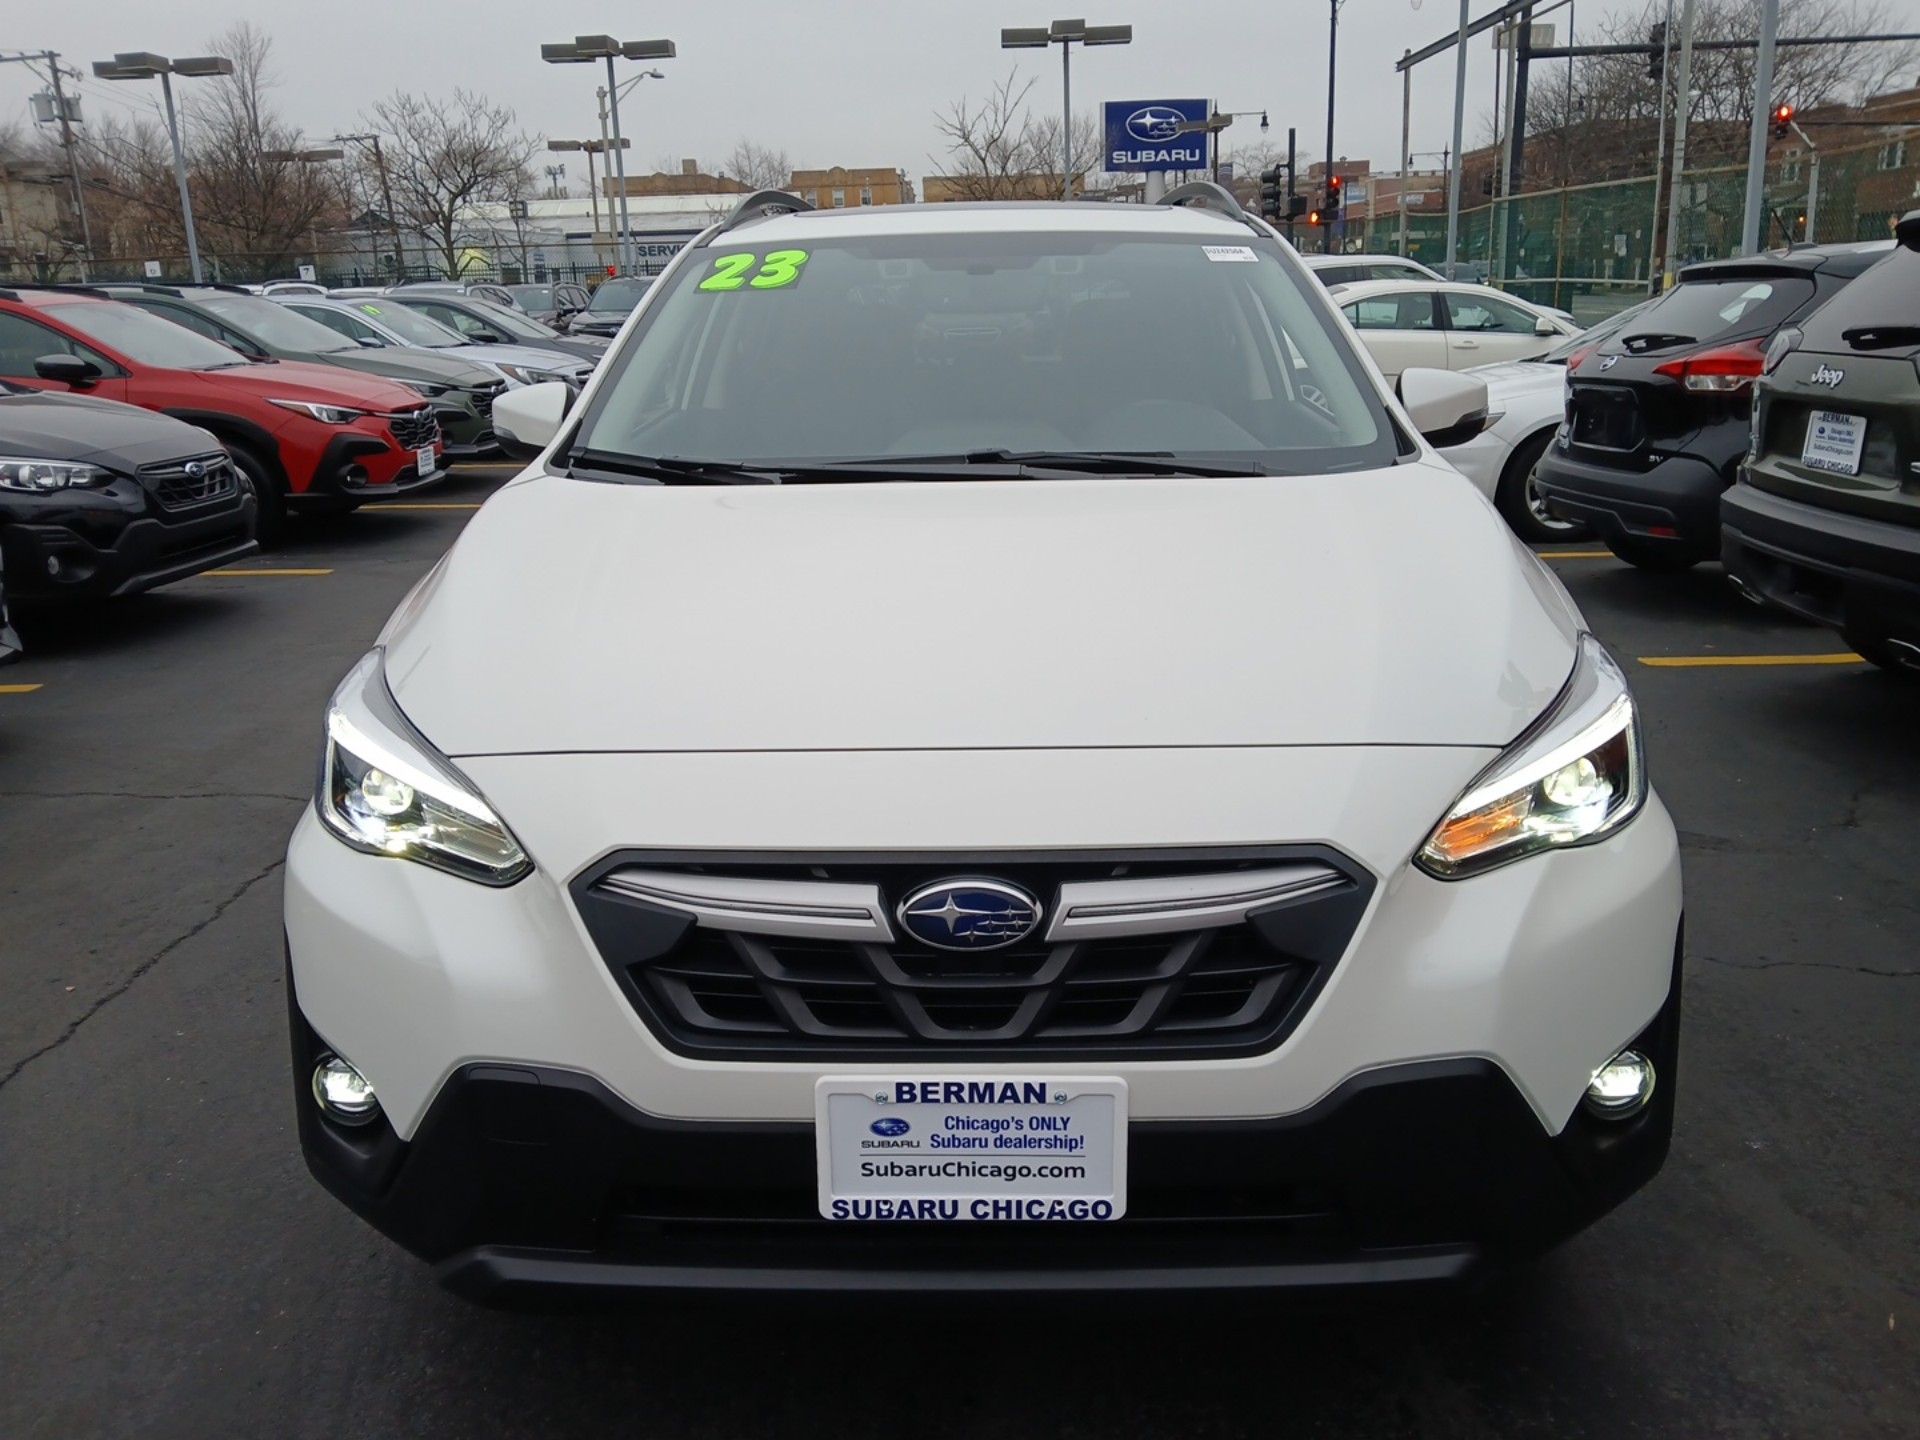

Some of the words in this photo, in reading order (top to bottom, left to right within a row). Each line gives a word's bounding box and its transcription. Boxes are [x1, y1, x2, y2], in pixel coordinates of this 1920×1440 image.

[1112, 149, 1200, 164] SUBARU
[638, 245, 685, 257] SERVI
[700, 250, 809, 291] 23
[1811, 364, 1844, 389] Jeep
[1822, 412, 1850, 425] BERMAN
[895, 1082, 1047, 1104] BERMAN
[944, 1115, 1024, 1133] Chicago's
[1029, 1116, 1071, 1131] ONLY
[861, 1140, 920, 1149] SUBARU
[930, 1134, 988, 1149] Subaru
[993, 1135, 1084, 1152] dealership!
[861, 1161, 1085, 1181] SubaruChicago.com
[831, 1199, 959, 1221] SUBARU
[970, 1199, 1113, 1221] CHICAGO
